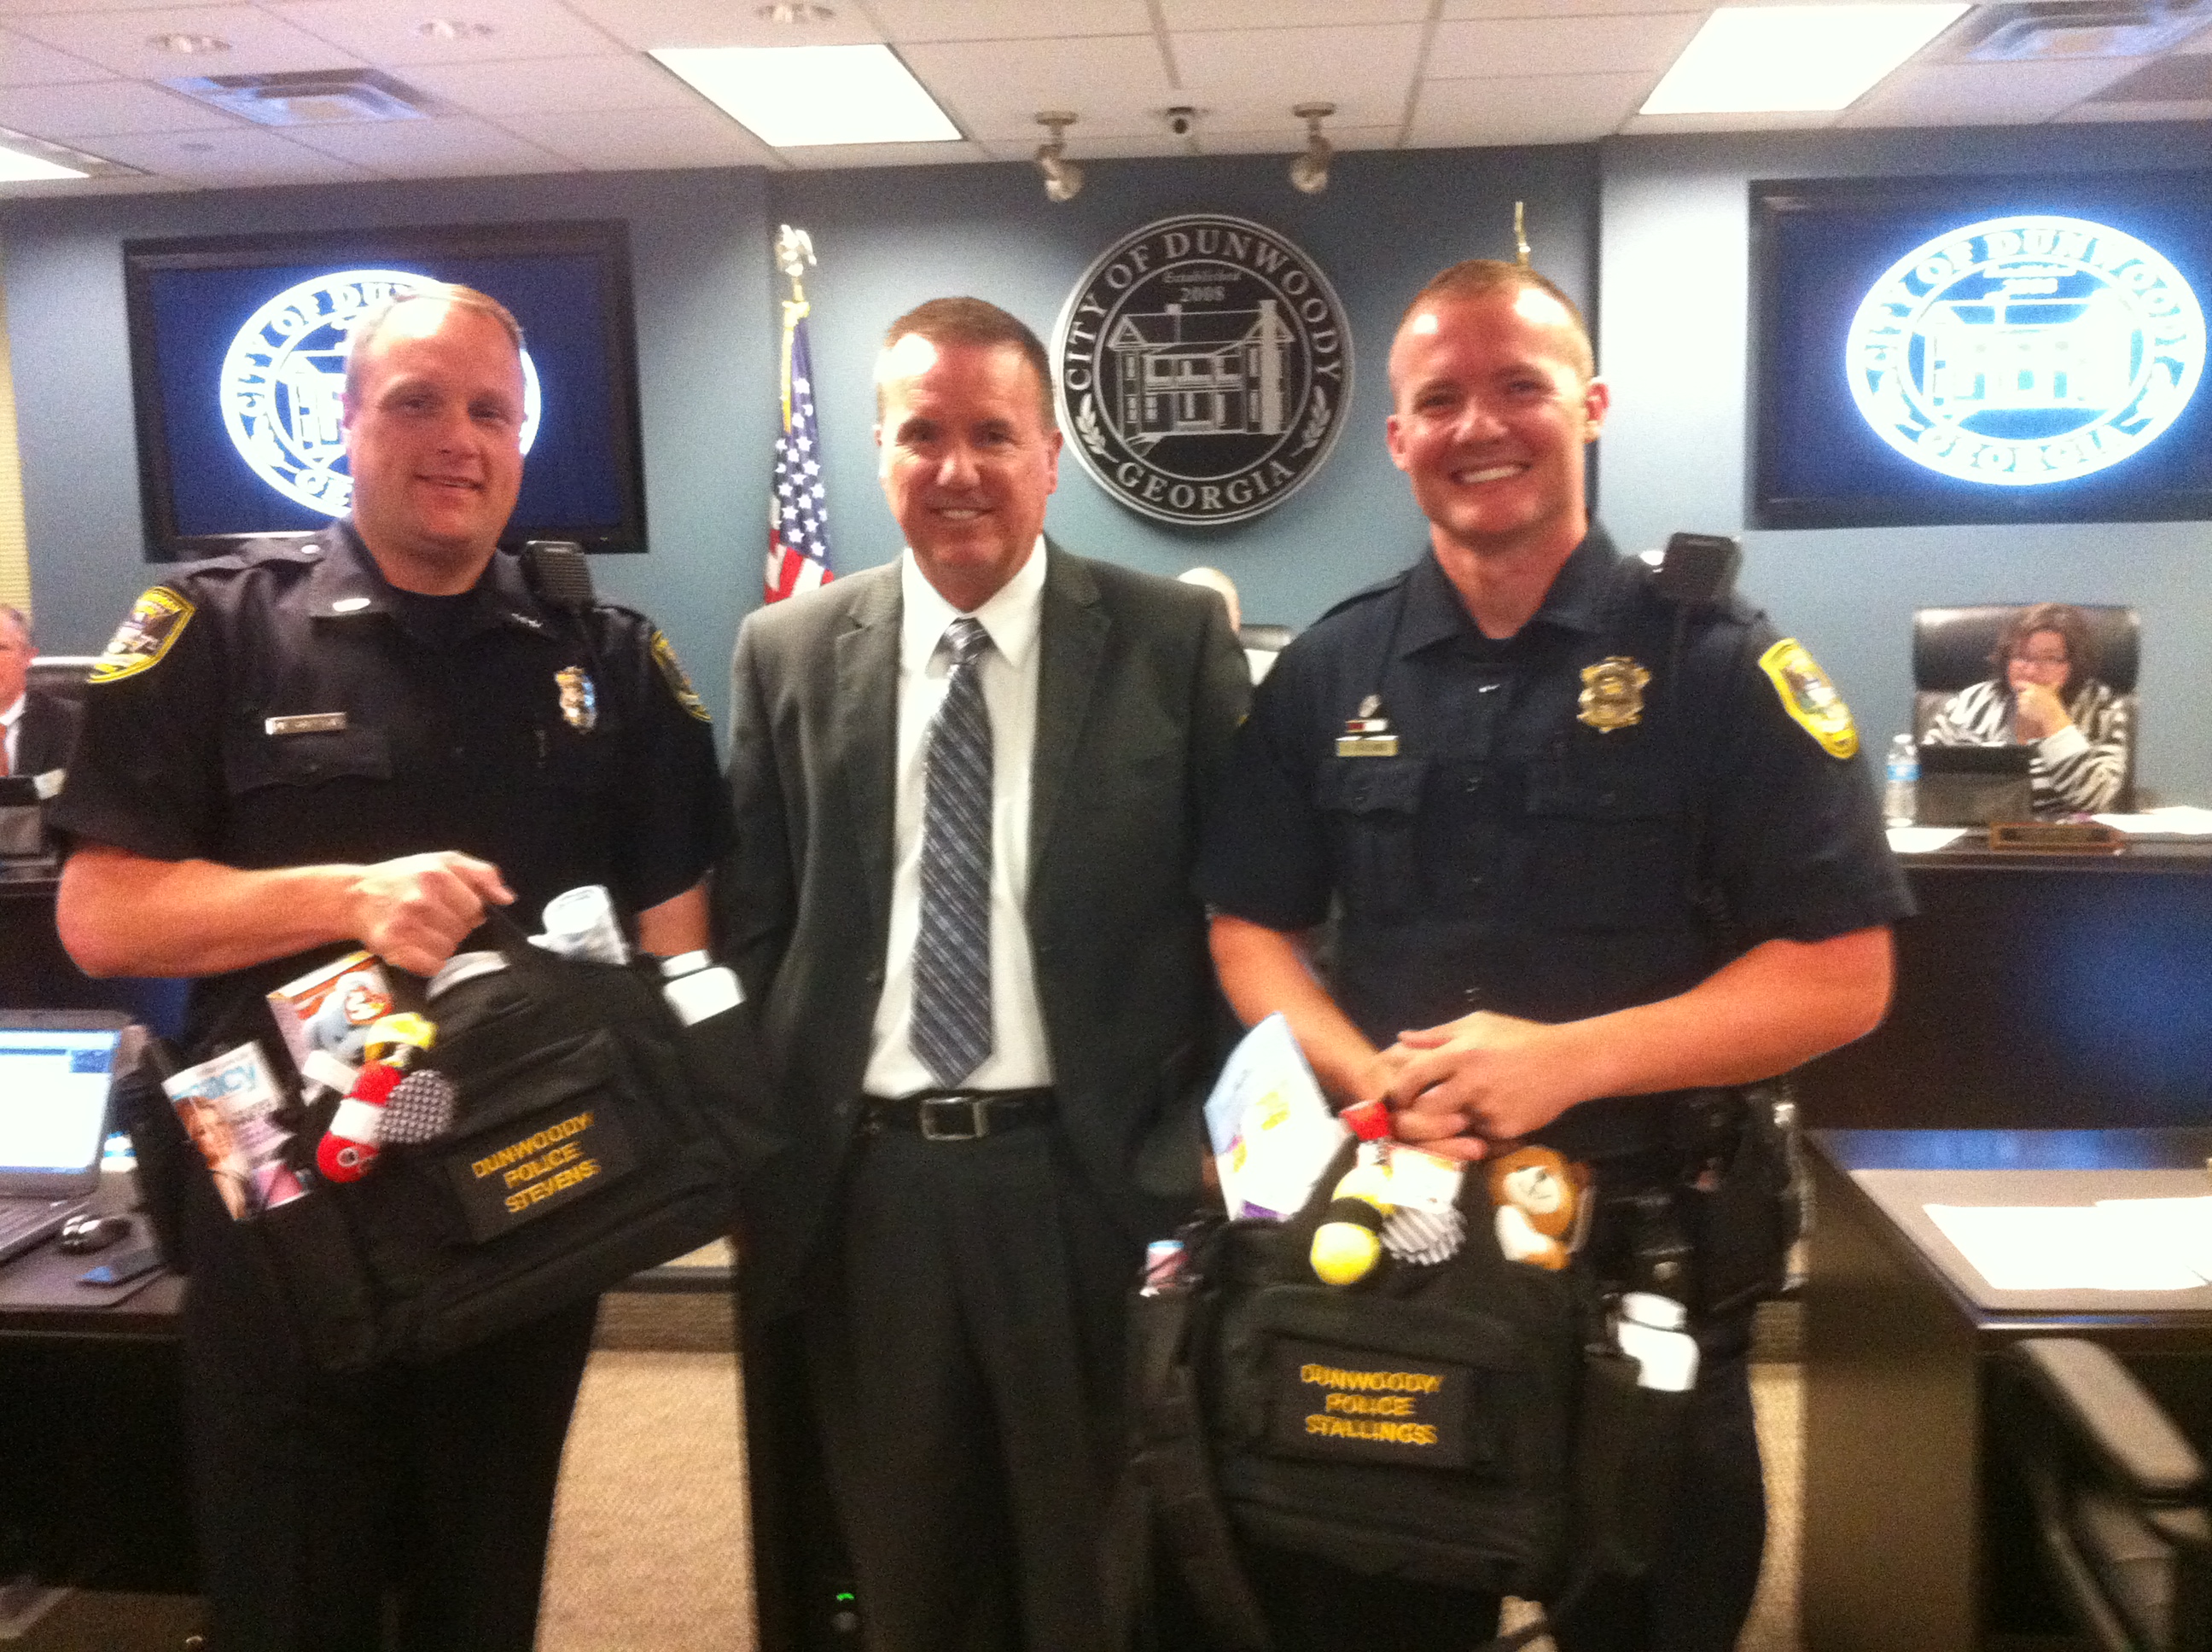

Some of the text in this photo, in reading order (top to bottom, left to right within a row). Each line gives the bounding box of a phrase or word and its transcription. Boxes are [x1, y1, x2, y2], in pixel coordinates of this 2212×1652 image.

[1065, 229, 1342, 391] CITY OF DUNWOODY
[1115, 458, 1296, 511] GEORGIA
[471, 1112, 595, 1178] DUNWOODY
[504, 1141, 584, 1189] POLICE
[504, 1158, 602, 1213] STEVENS
[1300, 1363, 1446, 1394] DUNWOODY
[1305, 1413, 1440, 1446] STALLINGS
[1325, 1393, 1417, 1416] POLICE
